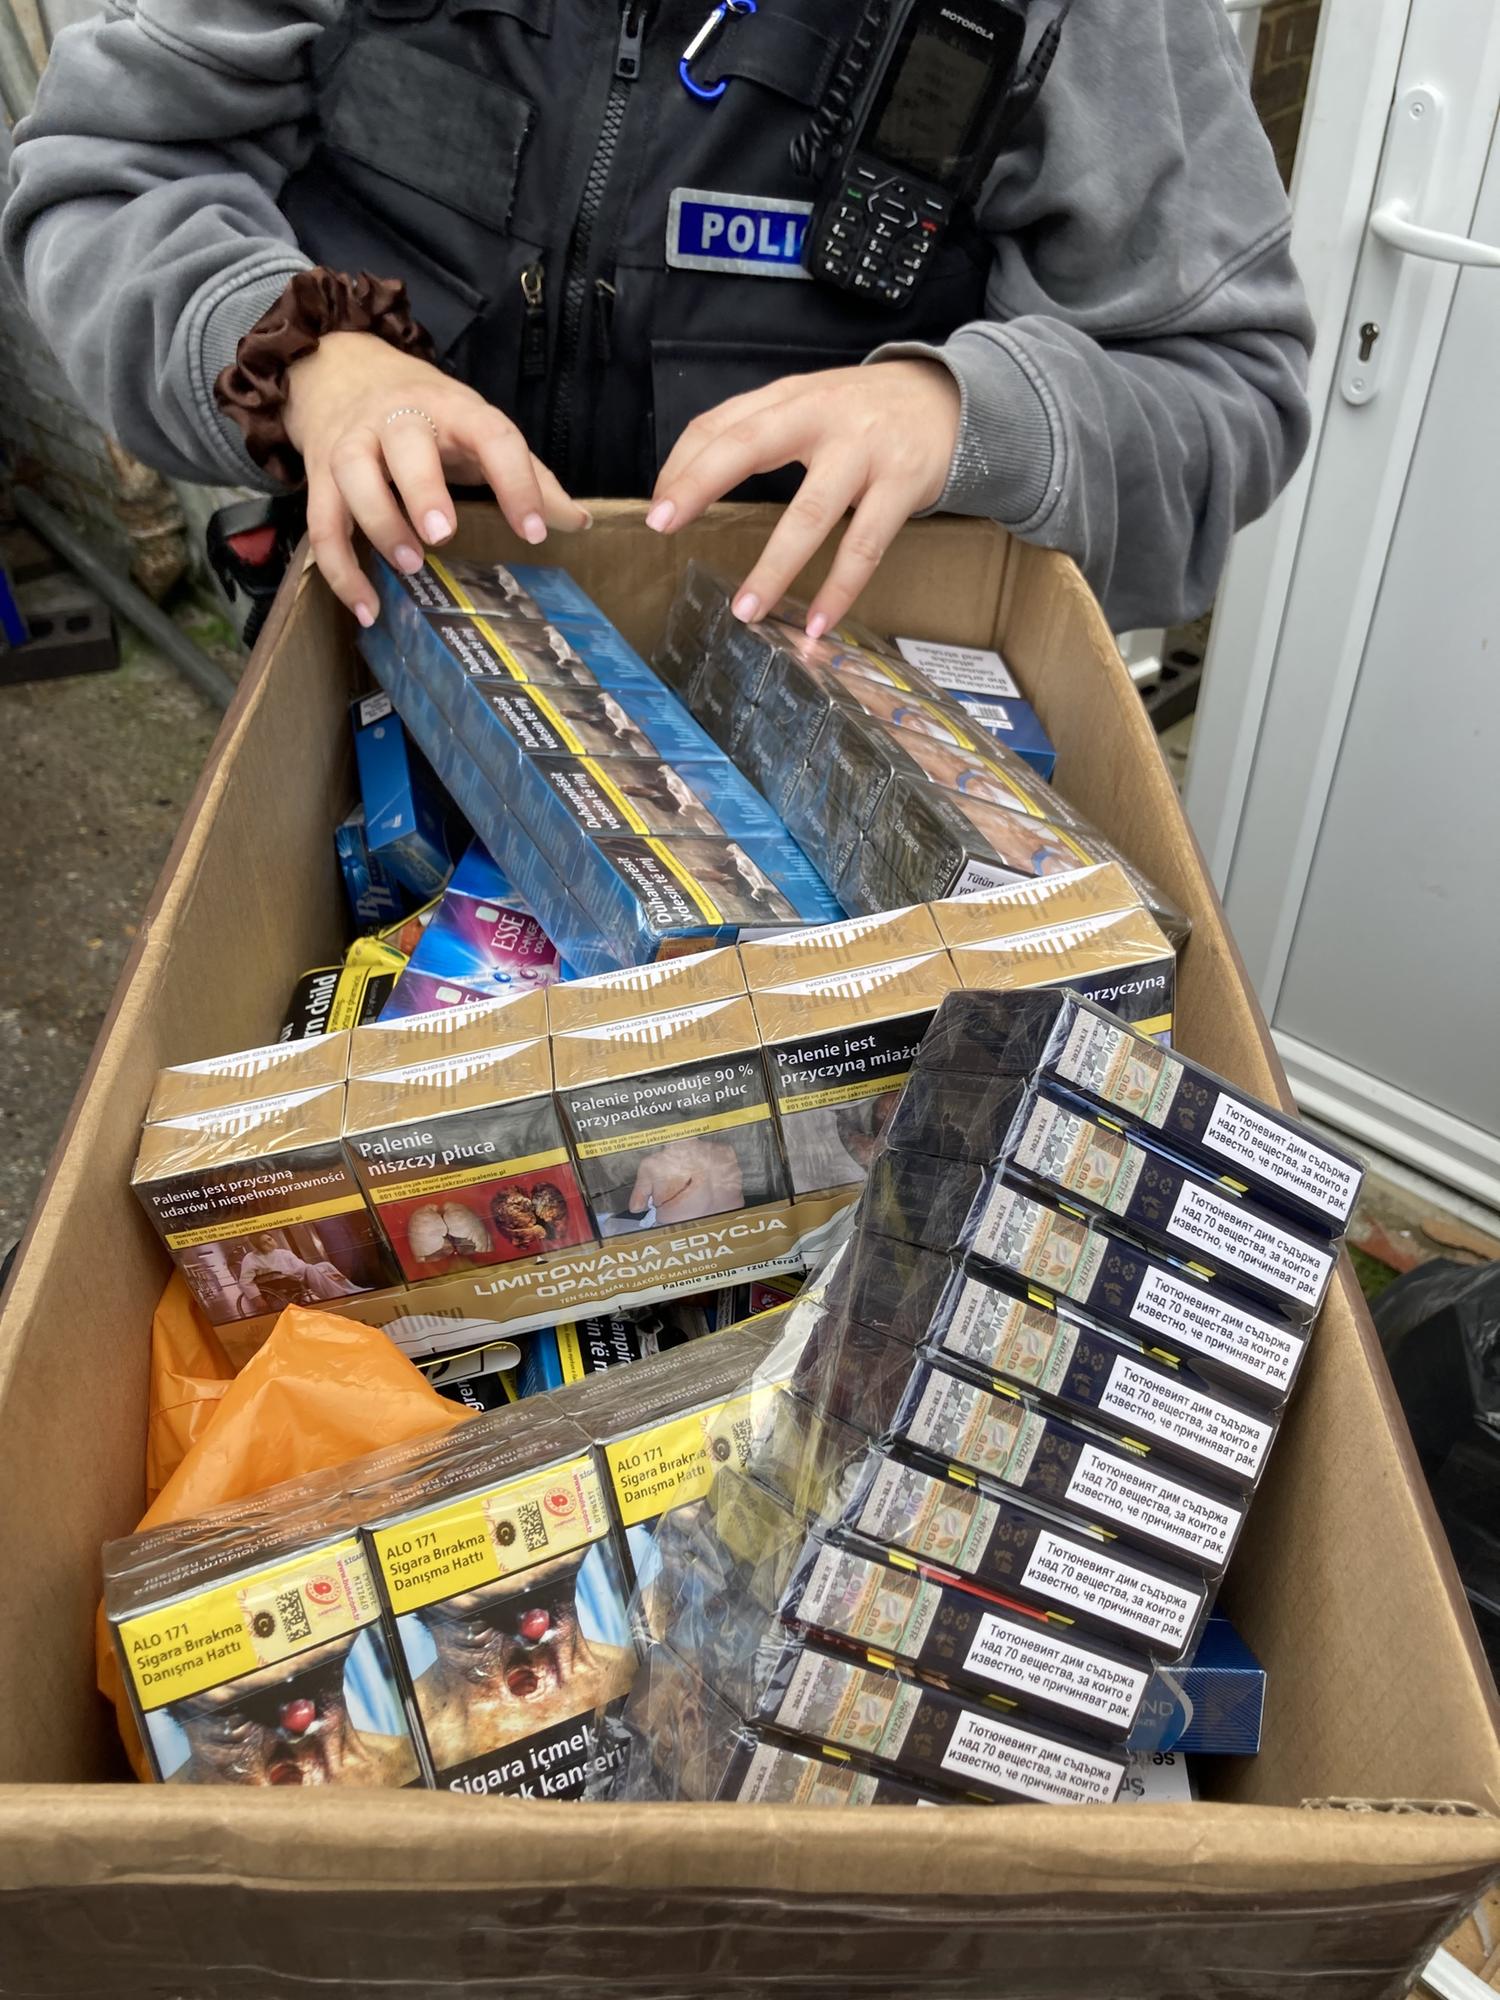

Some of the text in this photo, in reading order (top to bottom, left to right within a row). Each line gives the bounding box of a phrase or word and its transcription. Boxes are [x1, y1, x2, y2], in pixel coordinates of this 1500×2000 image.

[940, 8, 994, 40] MOTOROLA
[701, 211, 807, 258] POLI
[592, 799, 621, 830] vdesin
[616, 857, 672, 924] Duhanpirësit
[635, 857, 693, 922] vdesin të rinj
[967, 872, 995, 888] Tütün
[490, 913, 525, 951] ESSE
[305, 973, 338, 1015] child
[1083, 974, 1166, 1001] przyczyną
[776, 1035, 877, 1067] Palenie jest
[780, 1042, 921, 1088] przyczyną miażd
[570, 1063, 754, 1113] Palenie powoduje 90 %
[576, 1083, 748, 1132] przypadków raka płuc
[359, 1131, 433, 1158] Palenie
[368, 1141, 496, 1177] niszczy płuca
[1216, 1116, 1348, 1197] над 70 вещества, за които е
[1225, 1103, 1350, 1183] Тютюневият дим съдържа
[152, 1168, 294, 1207] Palenie jest przyczyną
[1207, 1127, 1346, 1211] известно, че причиняват рак.
[160, 1201, 209, 1219] udarów
[211, 1199, 217, 1209] i
[474, 1219, 788, 1297] LIMITOWANA EDYCJA
[536, 1245, 735, 1298] OPAKOWANIA
[662, 1255, 801, 1291] Palenie zabija rzuć teraz
[560, 1295, 577, 1304] TEN
[578, 1290, 598, 1300] SAM
[600, 1283, 626, 1296] SMAK
[668, 1262, 718, 1279] MARLBORO
[1145, 1290, 1288, 1366] над 70 вещества, за които е
[1154, 1276, 1291, 1352] Тютюневият дим съдържа
[590, 1341, 610, 1357] të
[1135, 1301, 1286, 1381] известно, че причиняват рак.
[1114, 1380, 1258, 1453] над 70 вещества, за които е
[1123, 1365, 1260, 1439] Тютюневият дим съдържа
[1104, 1391, 1255, 1468] известно, че причиняват рак.
[617, 1446, 663, 1473] ALO 171
[620, 1467, 658, 1488] Sigara
[624, 1477, 675, 1503] Danışma
[386, 1531, 437, 1560] ALO 171
[390, 1534, 486, 1576] Sigara Bırakma
[394, 1551, 484, 1591] Danışma Hattı
[1037, 1555, 1185, 1623] над 70 вещества, за които е
[1047, 1540, 1187, 1609] Тютюневият дим съдържа
[1027, 1567, 1182, 1638] известно, че причиняват рак.
[133, 1623, 189, 1653] ALO 171
[137, 1623, 243, 1671] Sigara Bırakma
[141, 1641, 241, 1686] Danışma Hattı
[449, 1725, 599, 1796] Sigara içmek
